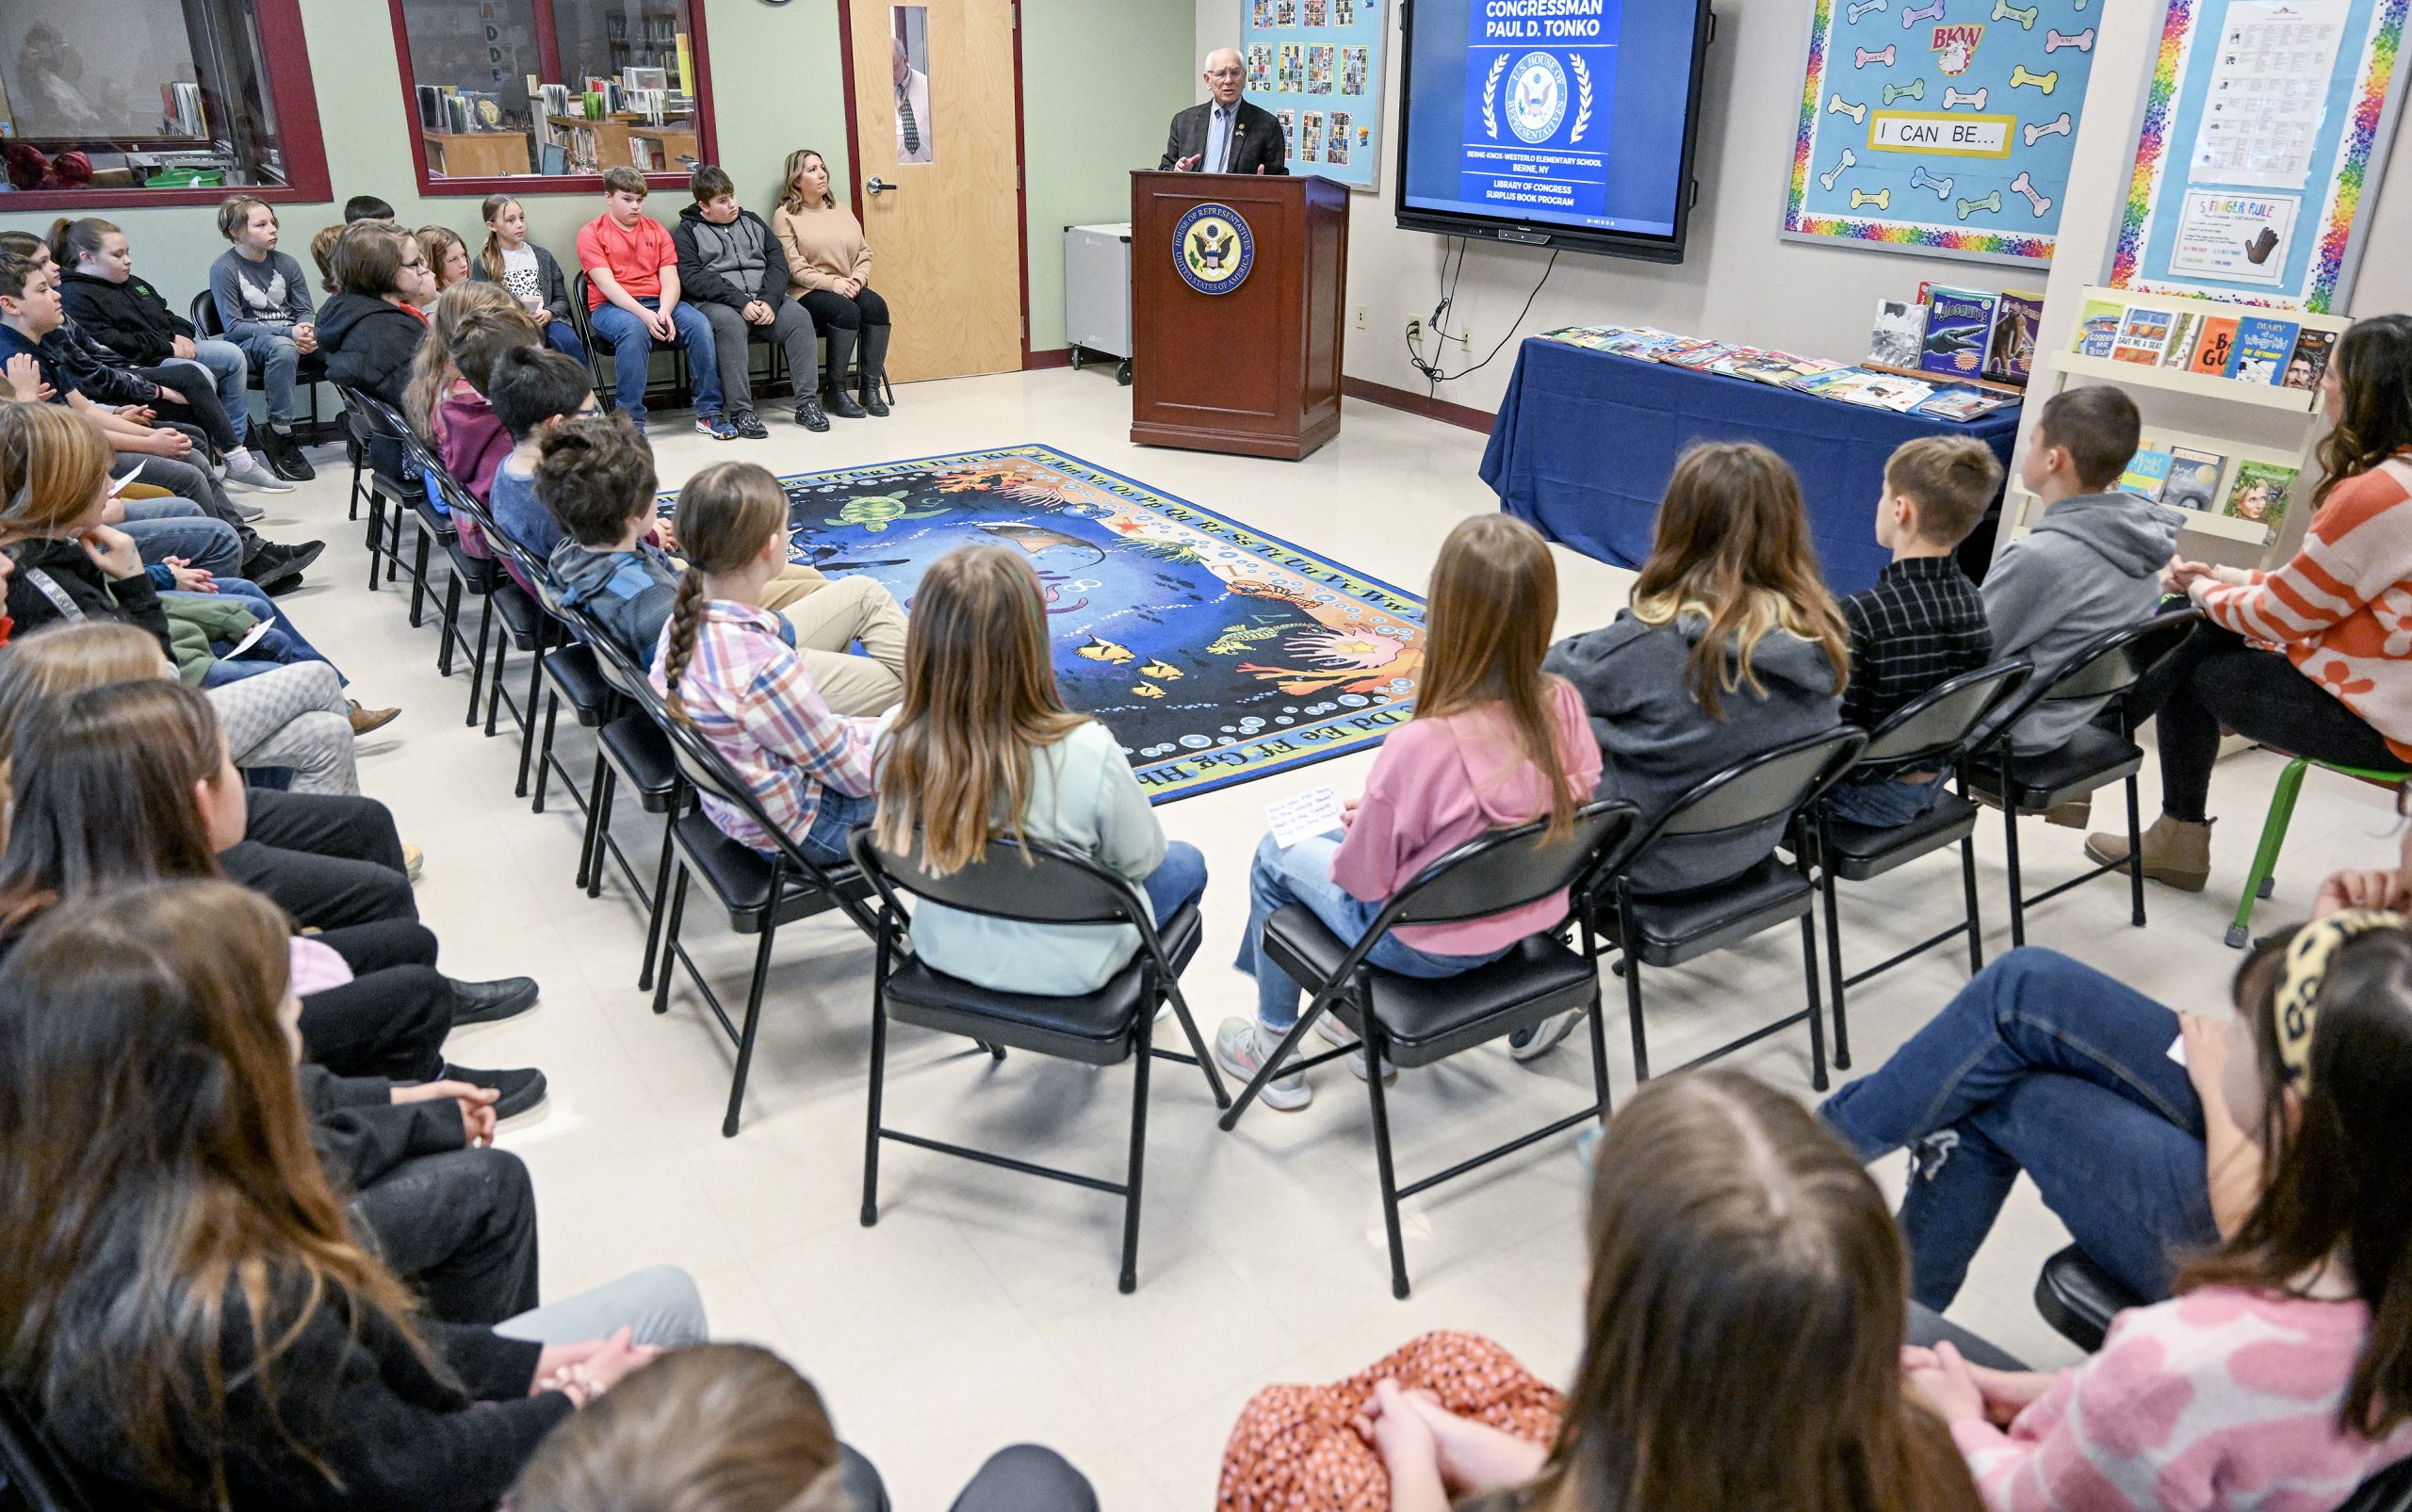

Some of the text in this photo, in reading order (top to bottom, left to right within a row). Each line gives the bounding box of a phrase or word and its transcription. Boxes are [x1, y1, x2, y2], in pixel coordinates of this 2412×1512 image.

[1486, 0, 1603, 17] CONGRESSMAN
[1486, 19, 1601, 37] PAUL D. TONKO
[1932, 26, 1982, 50] BKW
[1527, 56, 1555, 72] HOUSE
[1554, 71, 1564, 84] OF
[1508, 100, 1564, 139] REPRESENTATIVES
[1881, 122, 1995, 144] I CAN BE...
[1512, 163, 1549, 174] BERNE, NY
[1536, 154, 1576, 165] ELEMENTARY
[1576, 157, 1603, 167] SCHOOL
[1493, 180, 1573, 194] LIBRARY OF CONGRESS
[1486, 190, 1574, 206] SURPLUS BOOK PROGRAM
[2199, 201, 2206, 213] 5
[2208, 201, 2245, 214] FINGER
[2248, 202, 2275, 218] RULE
[1175, 207, 1251, 251] HOUSE OF REPRESENTATIVES
[1175, 251, 1193, 280] UNITED
[1192, 277, 1217, 291] STATES
[1229, 253, 1250, 285] AMERICA
[1934, 301, 1988, 323] ylosaurus
[2257, 321, 2285, 332] DIARY
[2117, 336, 2131, 345] SAVE
[2088, 347, 2111, 356] TERUP
[1081, 473, 1107, 486] Nn
[1109, 485, 1135, 496] Oo
[1136, 496, 1164, 510] Pp
[1165, 508, 1192, 523] Qq
[1194, 520, 1225, 533] Rr
[1225, 533, 1253, 546] Ss
[1255, 545, 1284, 560] Tt
[1284, 558, 1320, 576] Uu
[1324, 574, 1357, 591] Vv
[1361, 590, 1409, 611] Ww
